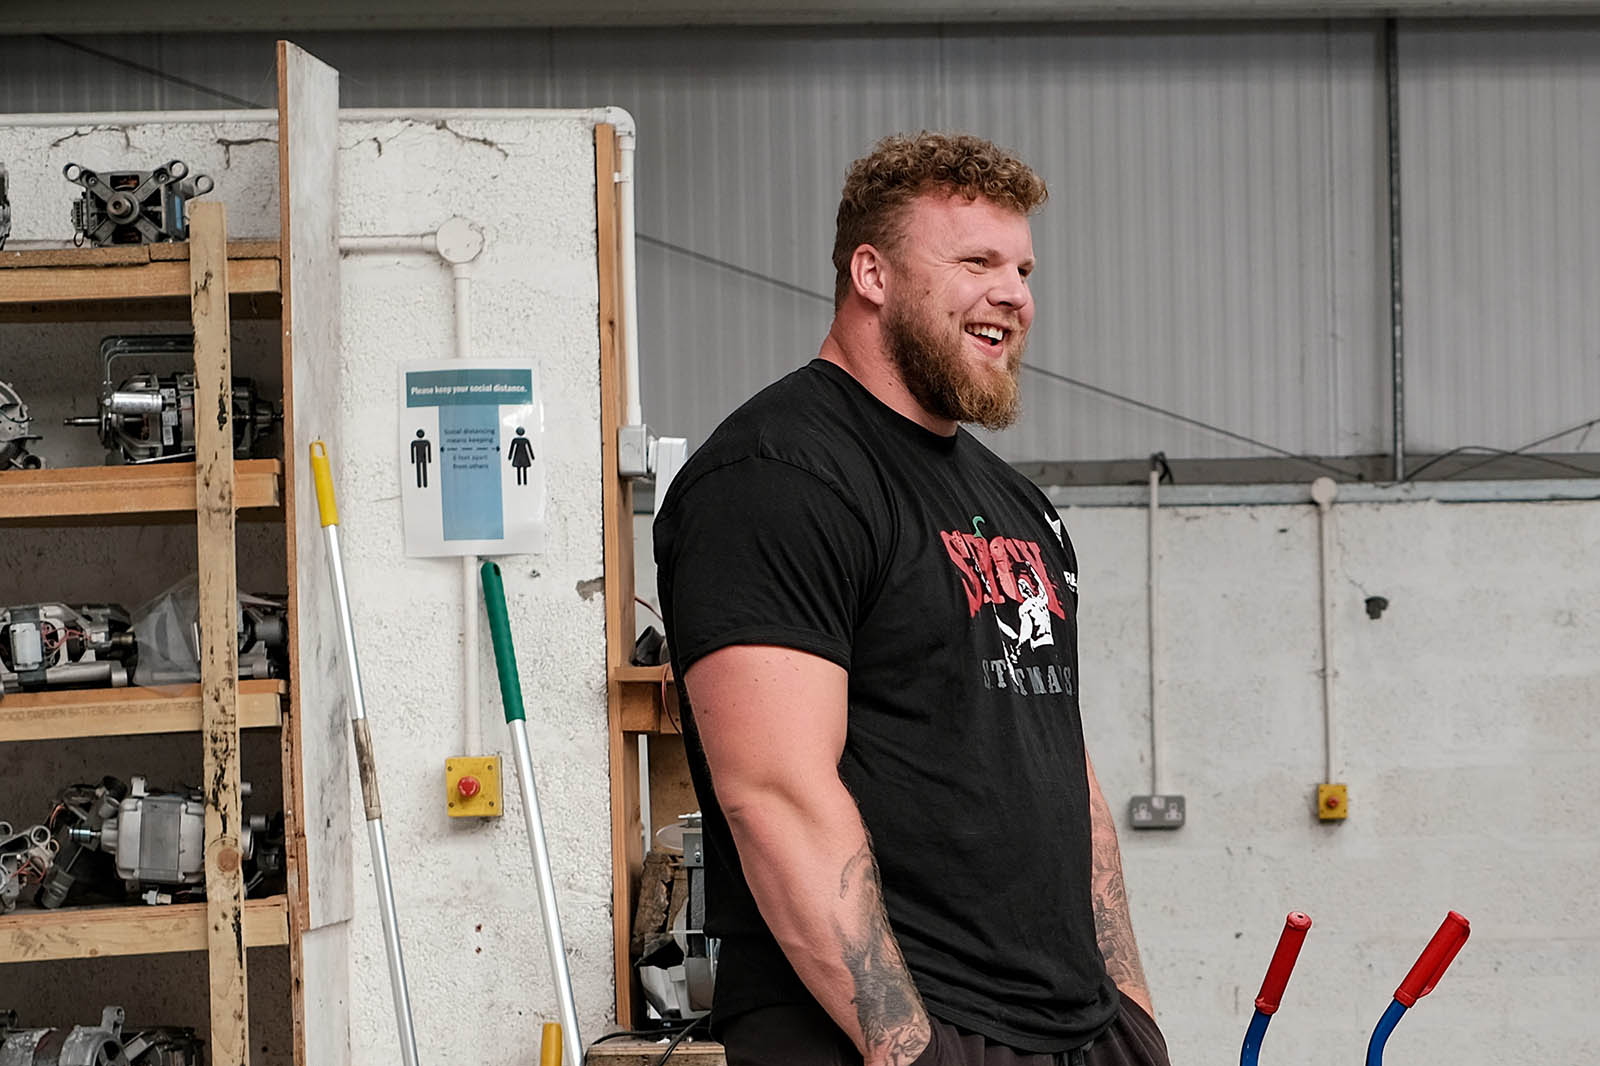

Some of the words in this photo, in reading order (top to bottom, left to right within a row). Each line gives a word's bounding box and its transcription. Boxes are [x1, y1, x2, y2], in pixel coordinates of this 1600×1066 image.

[411, 386, 434, 395] Please
[435, 385, 452, 395] keep
[452, 385, 469, 395] your
[469, 383, 492, 393] social
[493, 383, 528, 393] distance.
